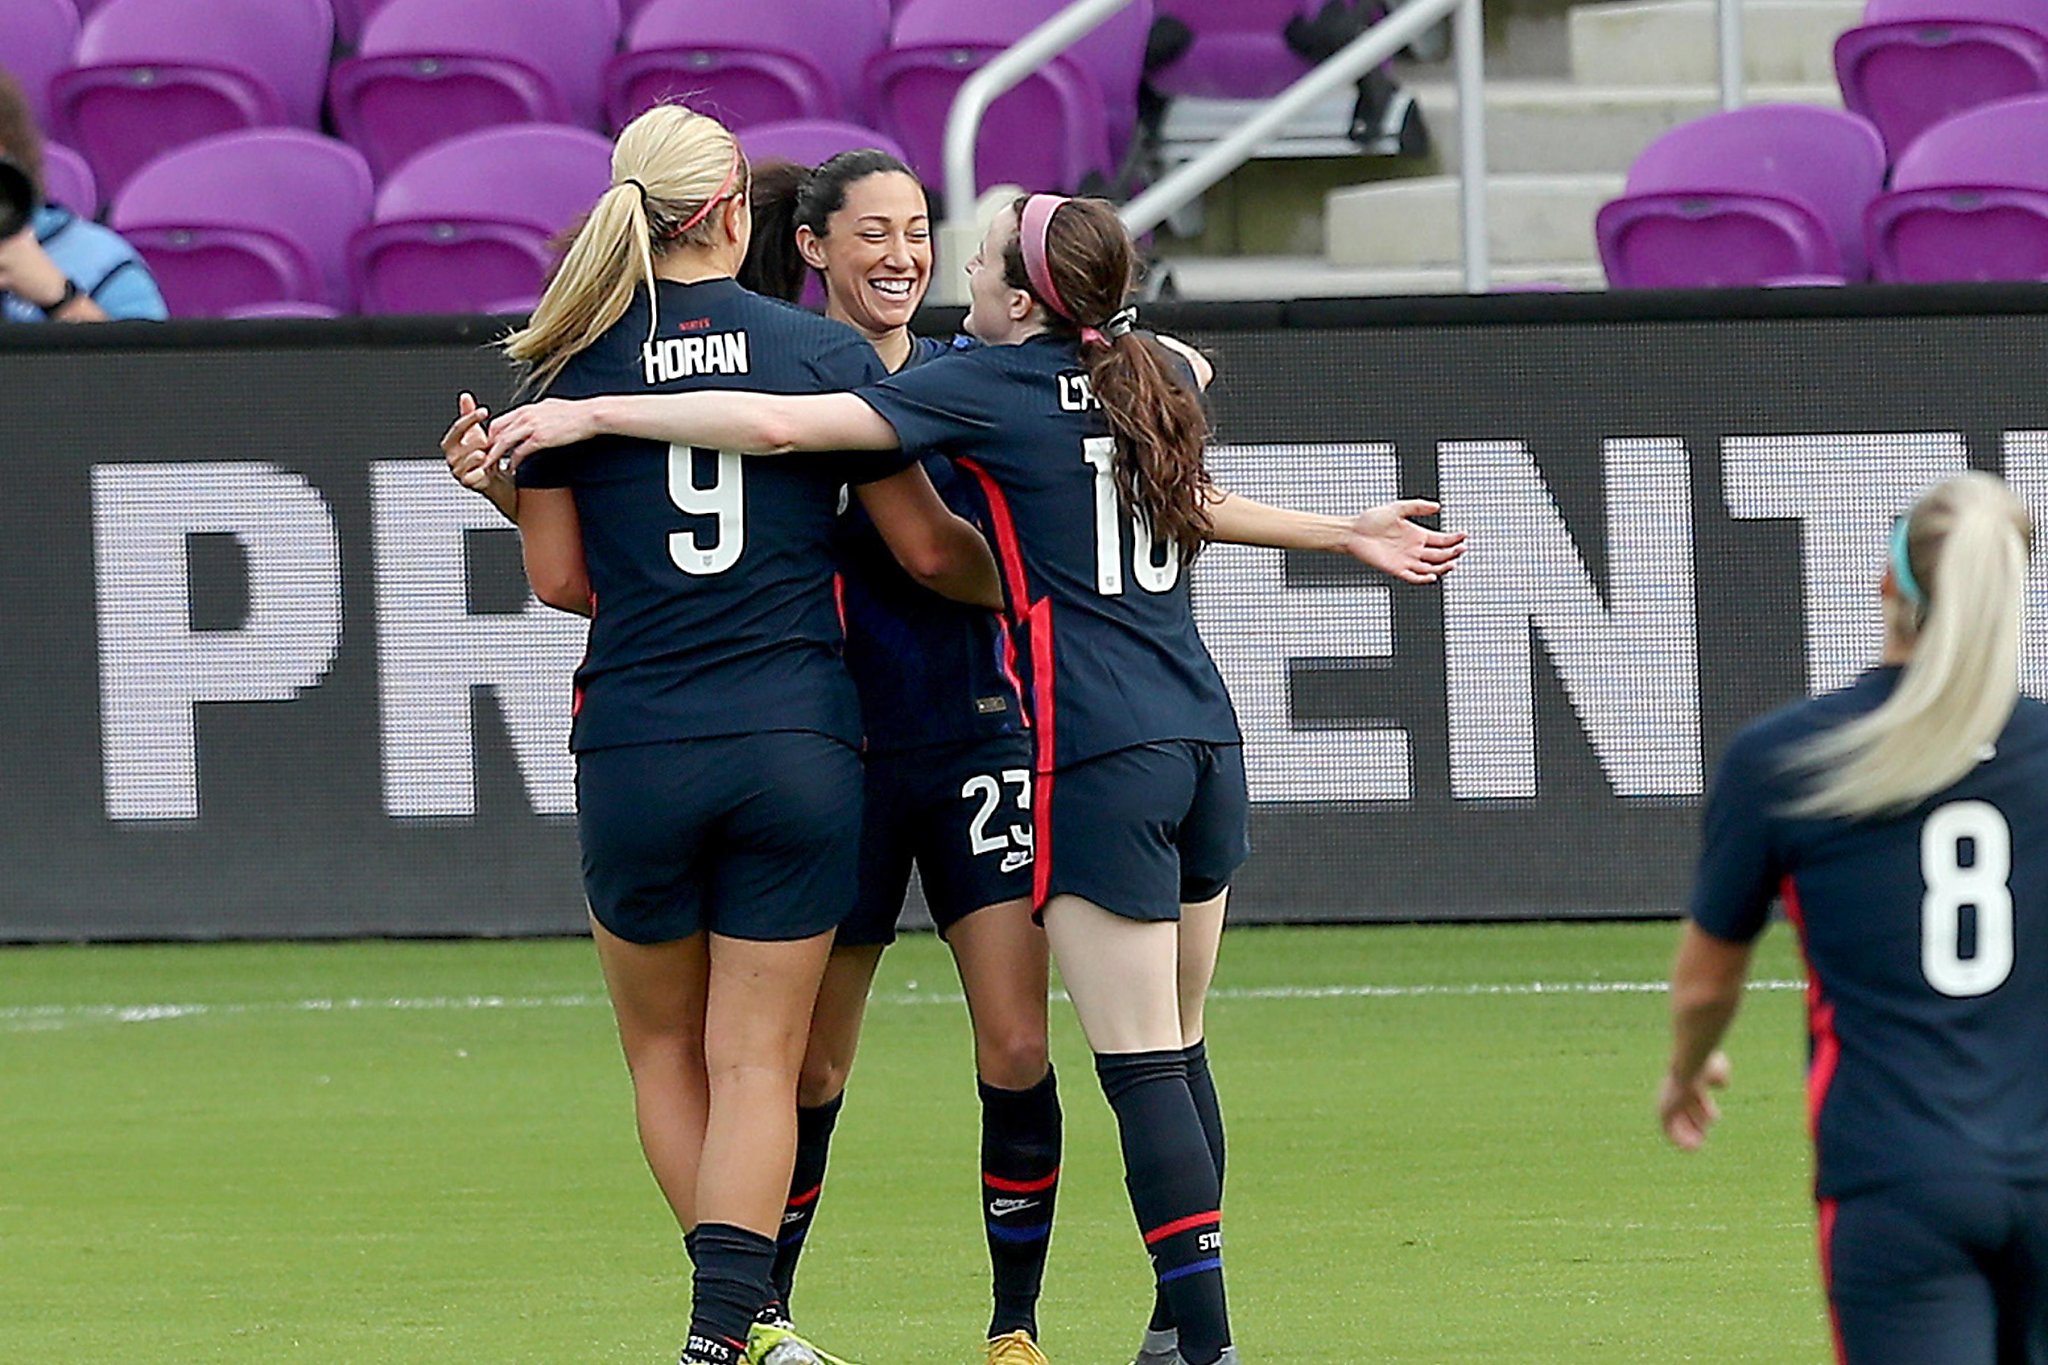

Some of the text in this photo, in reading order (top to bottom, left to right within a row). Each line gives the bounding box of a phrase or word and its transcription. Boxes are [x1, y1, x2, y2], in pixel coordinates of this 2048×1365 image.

[643, 331, 748, 384] HORAN
[1058, 374, 1101, 411] LA
[668, 443, 744, 575] 9
[961, 769, 1034, 856] 23
[1921, 800, 2015, 998] 8
[689, 1335, 729, 1360] TATES
